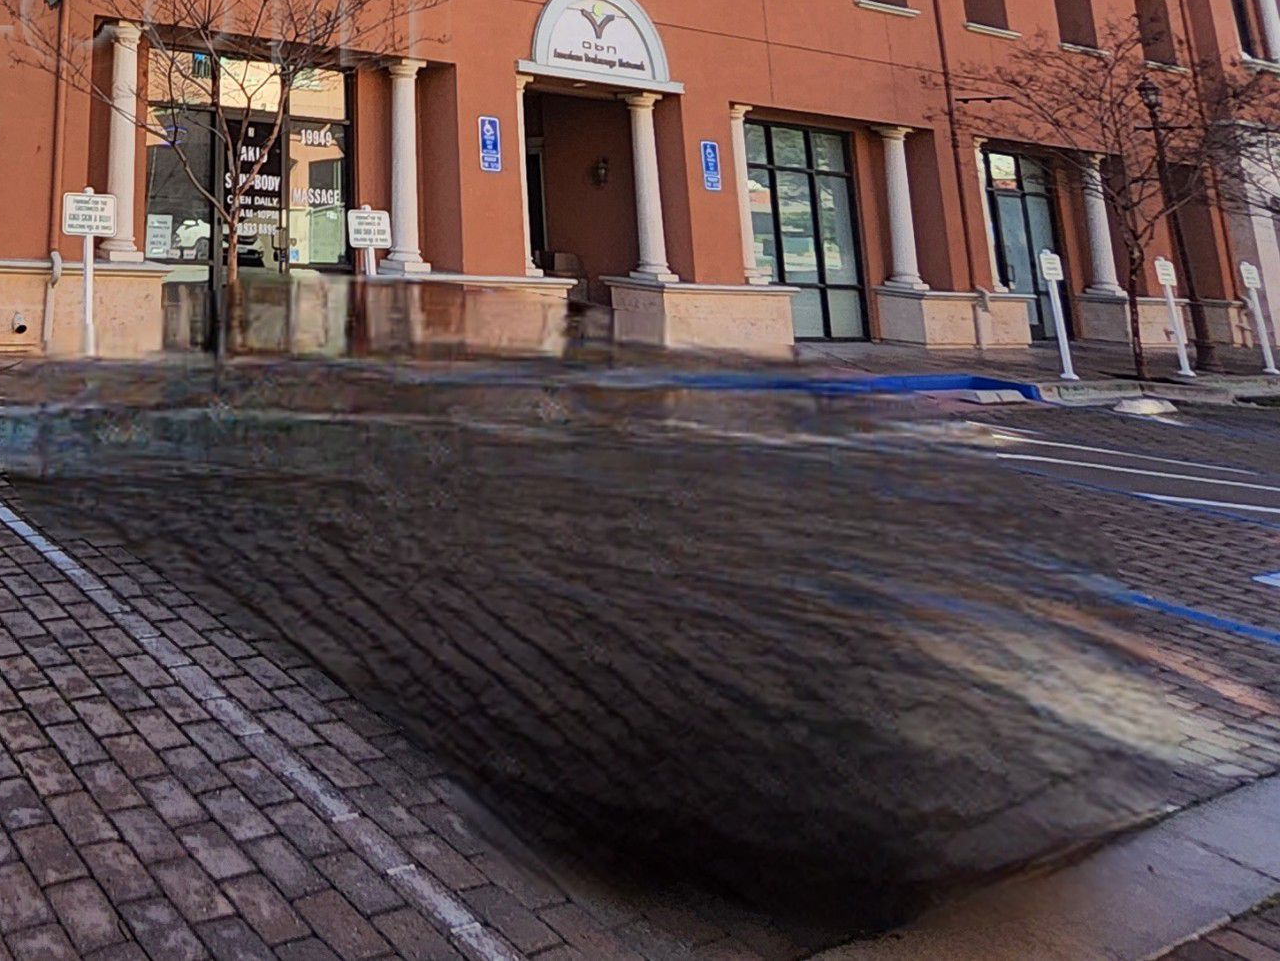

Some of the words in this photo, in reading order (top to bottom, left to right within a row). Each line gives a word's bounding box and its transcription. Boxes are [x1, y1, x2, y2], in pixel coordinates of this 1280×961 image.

[225, 172, 281, 191] SI-BODY
[226, 194, 252, 205] OEN
[292, 187, 340, 206] MASSAGE
